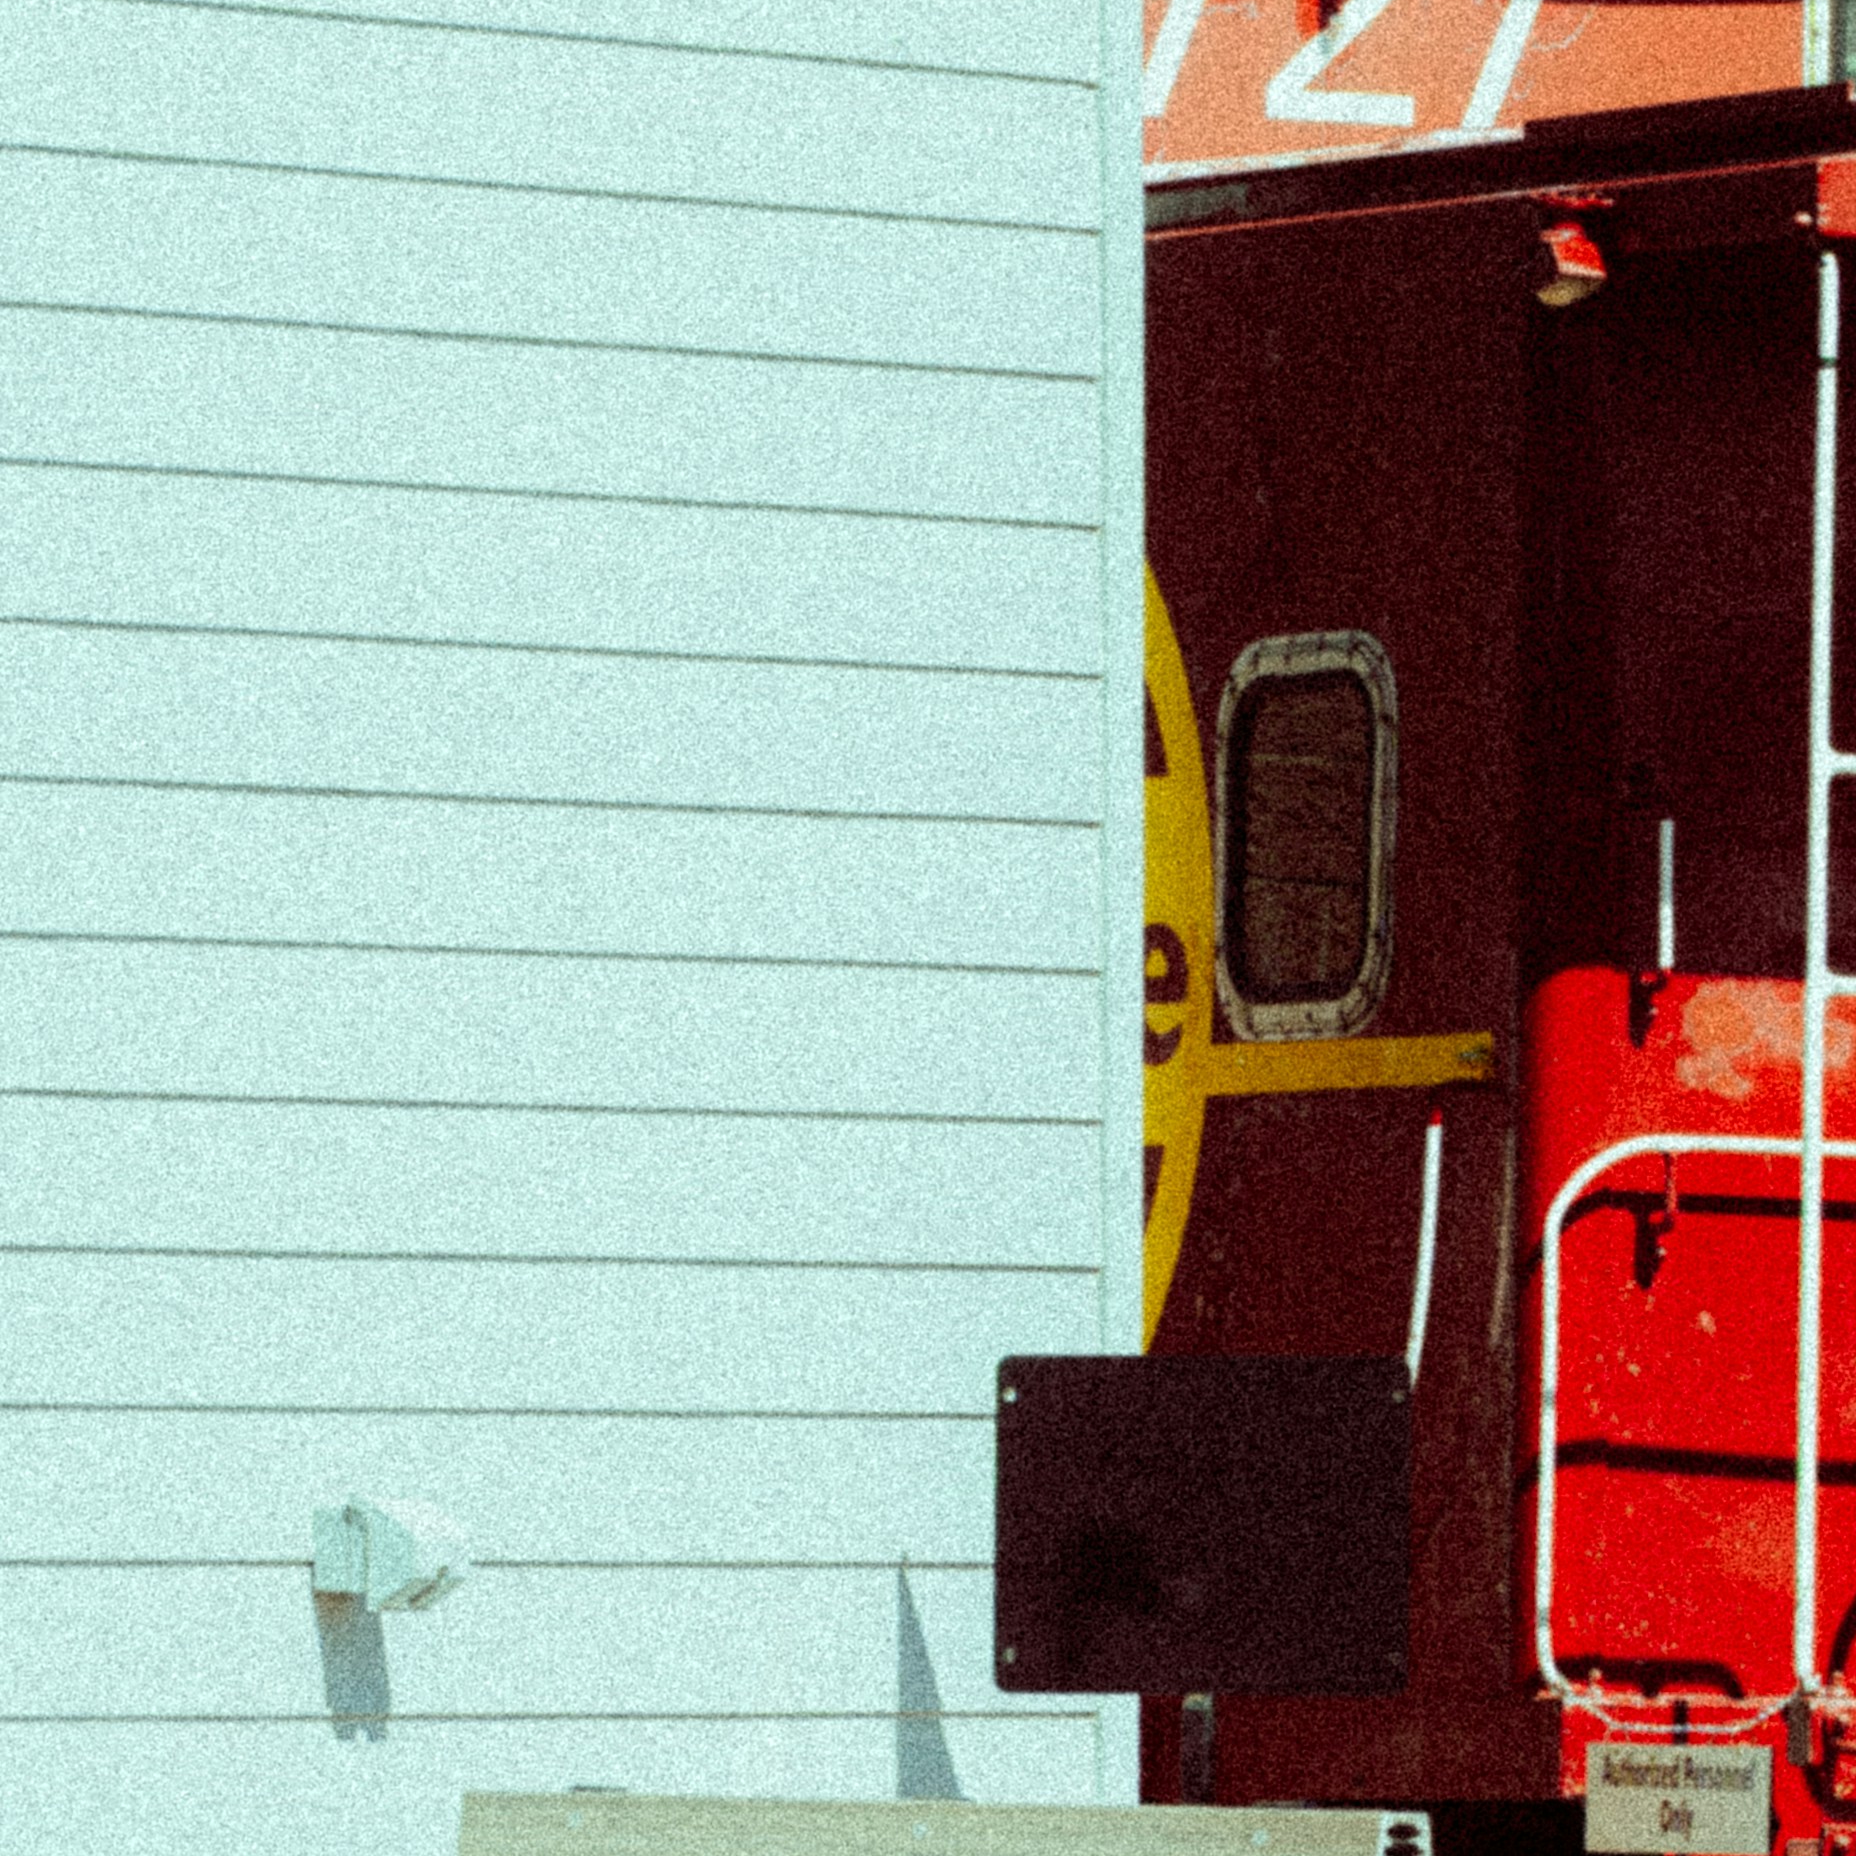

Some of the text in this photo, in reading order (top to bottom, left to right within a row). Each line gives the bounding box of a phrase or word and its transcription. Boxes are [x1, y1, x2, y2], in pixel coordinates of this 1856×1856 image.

[1601, 1754, 1757, 1792] Authorized Personnel
[1659, 1798, 1694, 1842] Only
